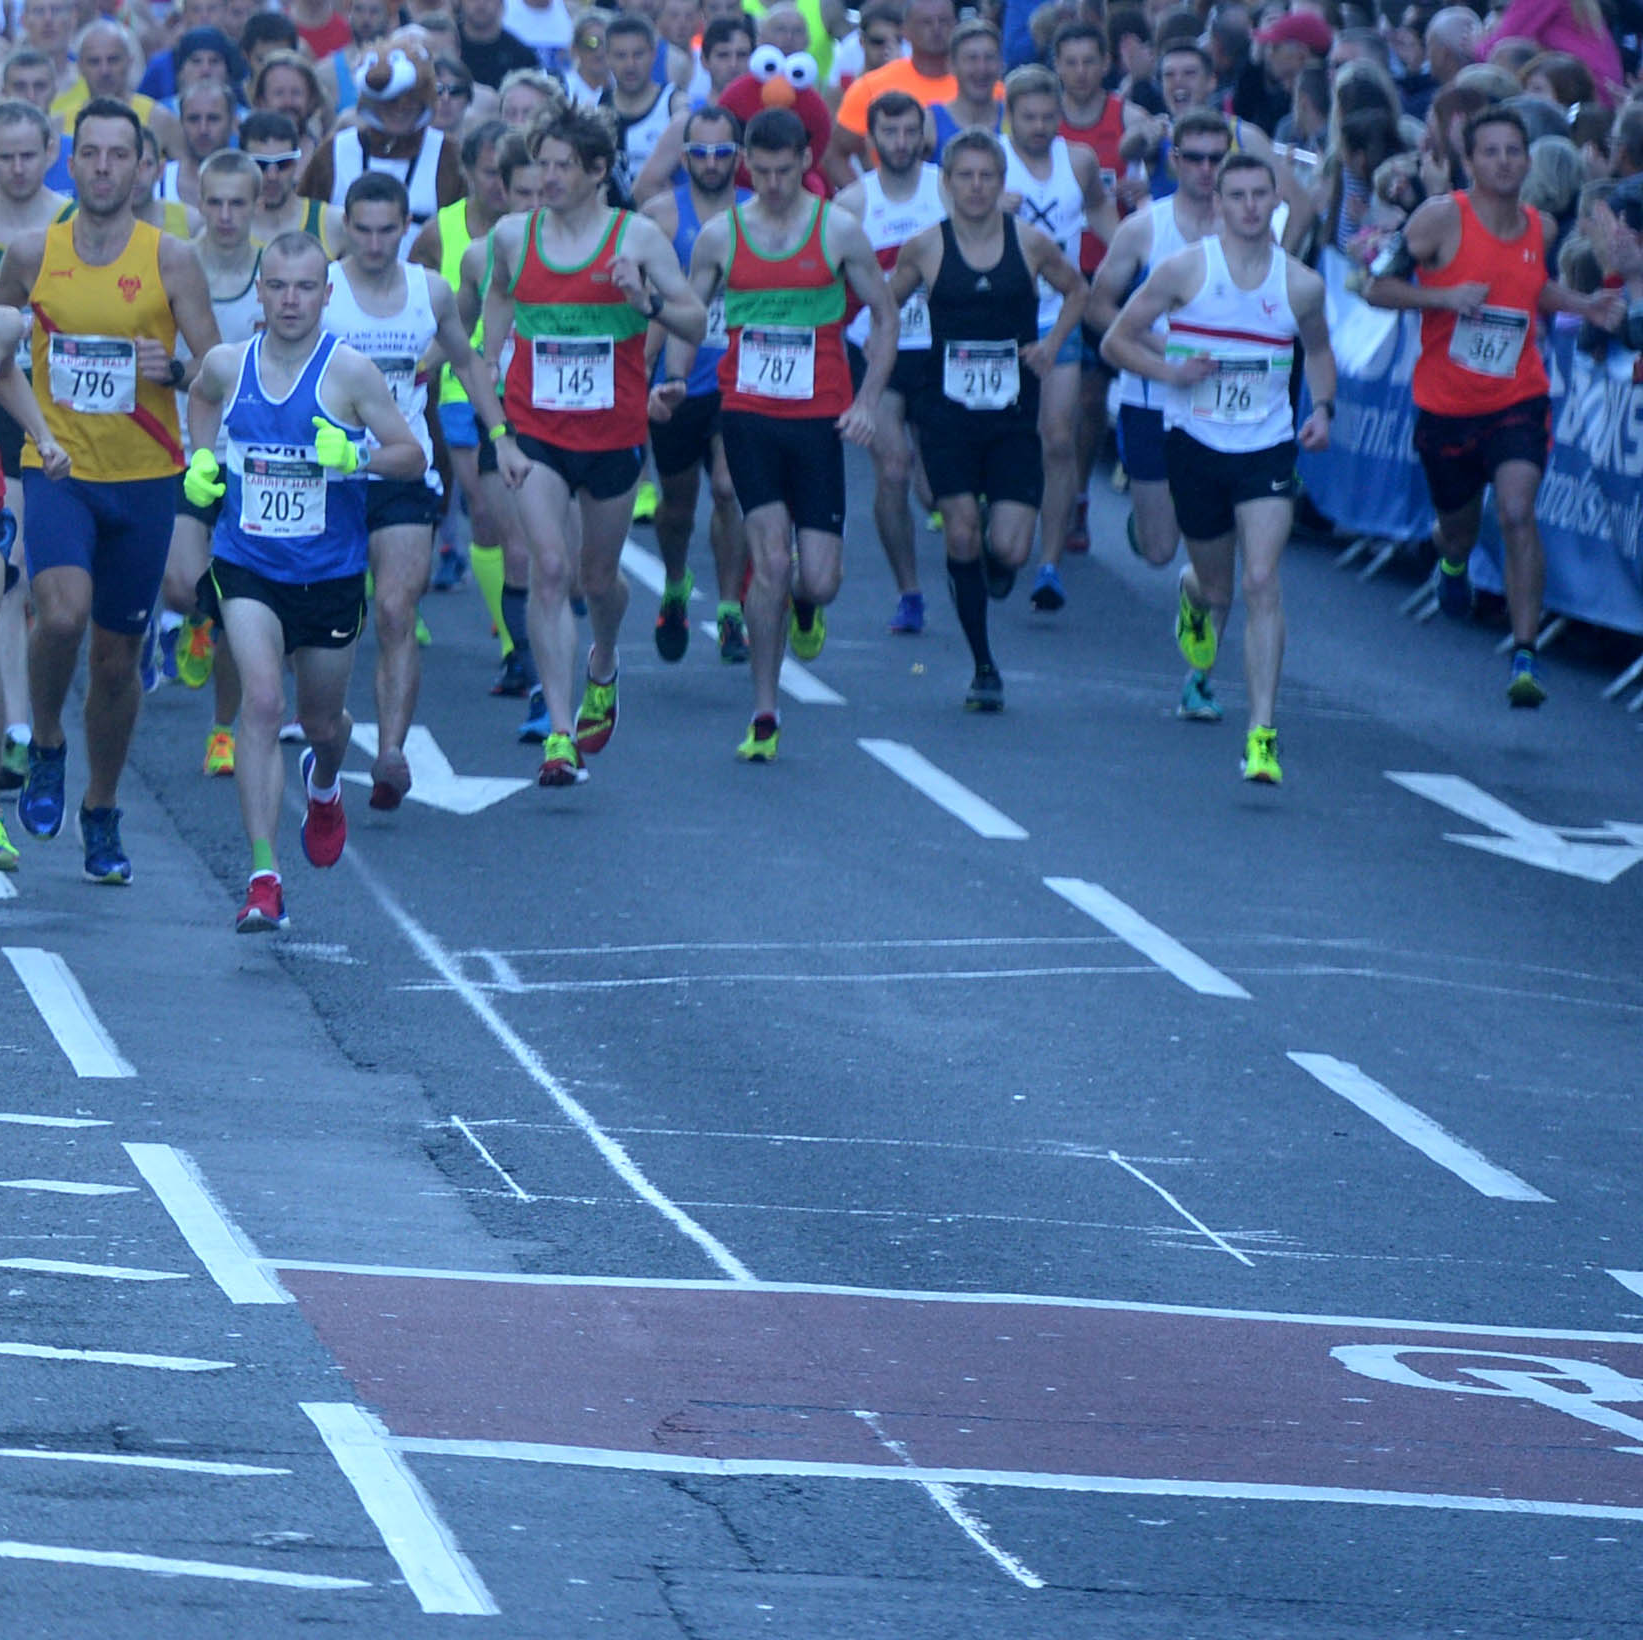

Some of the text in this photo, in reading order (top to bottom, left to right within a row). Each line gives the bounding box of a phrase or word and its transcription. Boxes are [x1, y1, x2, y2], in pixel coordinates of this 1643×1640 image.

[70, 369, 115, 399] 796
[557, 368, 594, 395] 145
[758, 355, 796, 384] 787
[964, 368, 1002, 393] 219
[1215, 380, 1251, 411] 126
[260, 490, 306, 522] 205
